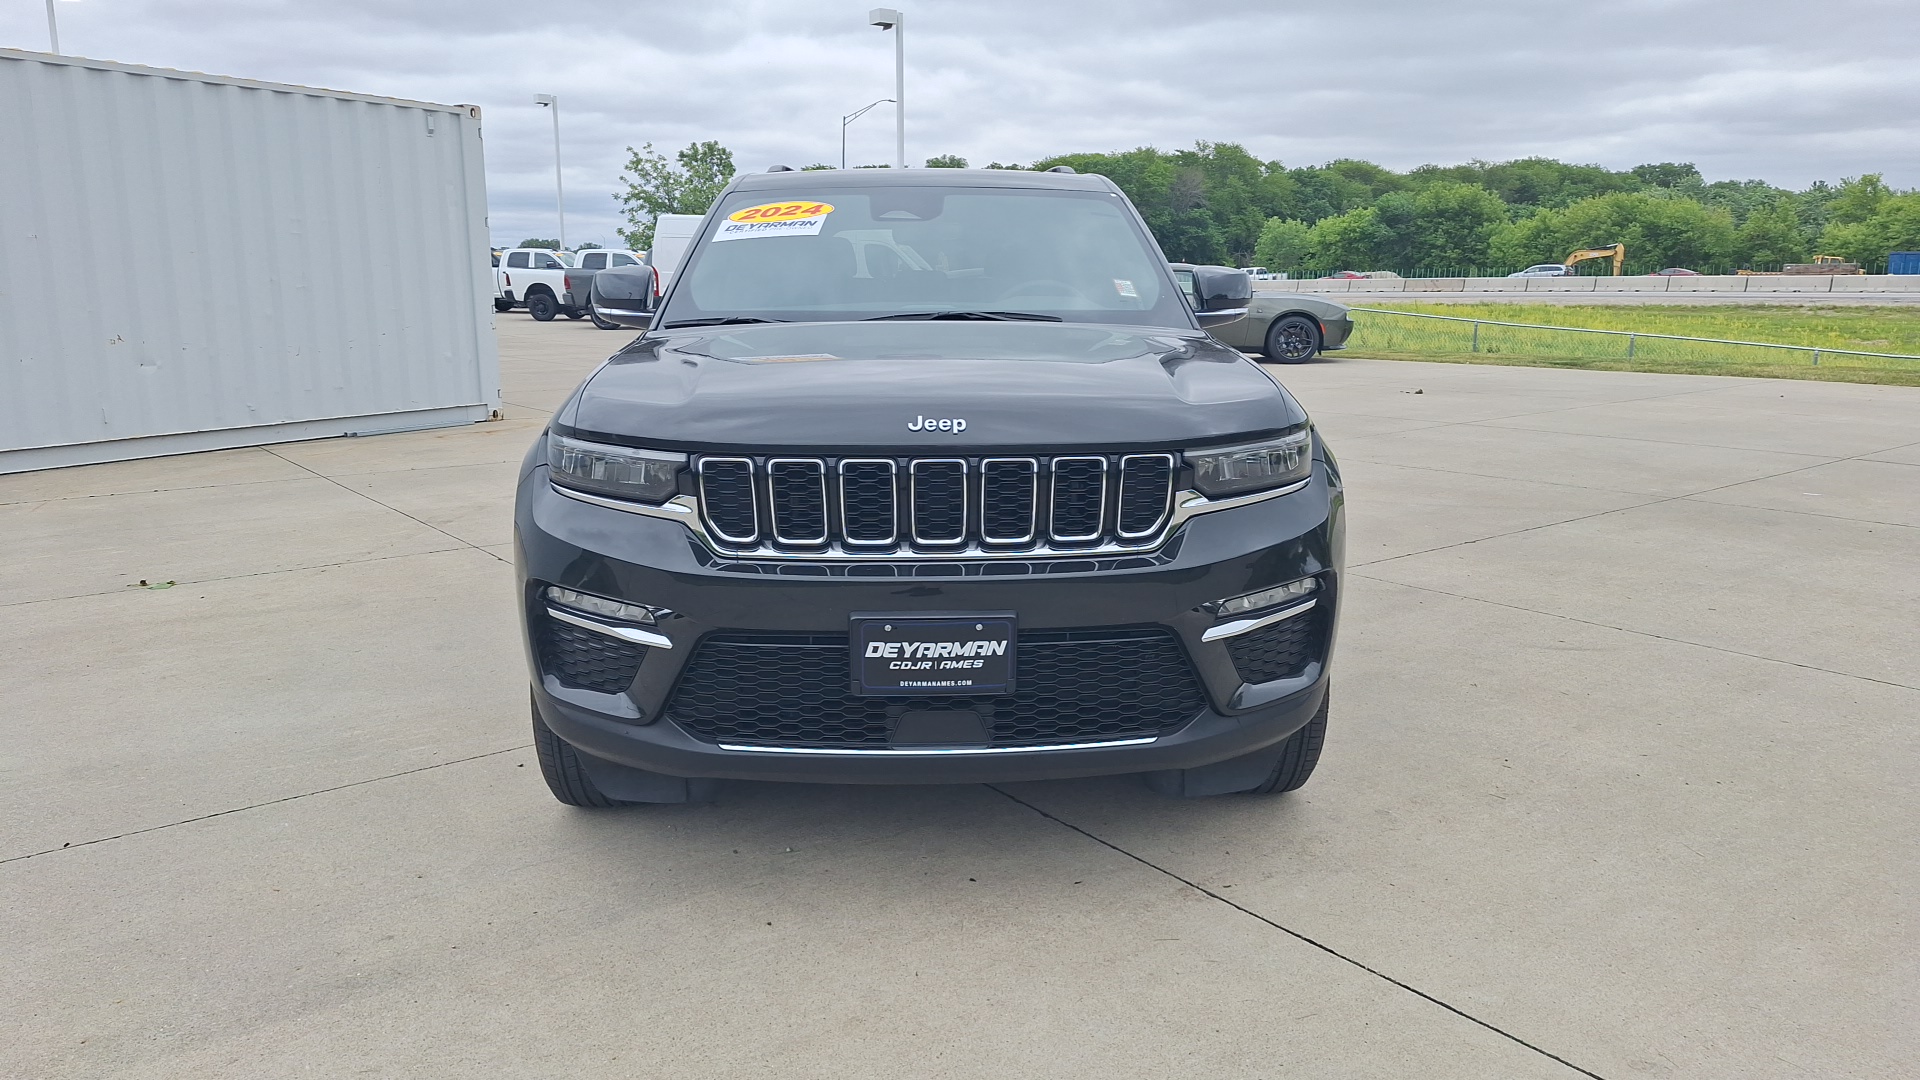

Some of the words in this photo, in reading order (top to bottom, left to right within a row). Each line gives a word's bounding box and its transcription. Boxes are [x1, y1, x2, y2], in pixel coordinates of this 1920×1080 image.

[737, 204, 825, 221] 2024
[724, 220, 818, 232] DEYARMAN
[907, 415, 967, 434] Jeep
[864, 640, 1008, 658] DEYARMAN
[889, 661, 933, 670] CDJR
[939, 659, 985, 670] AMES
